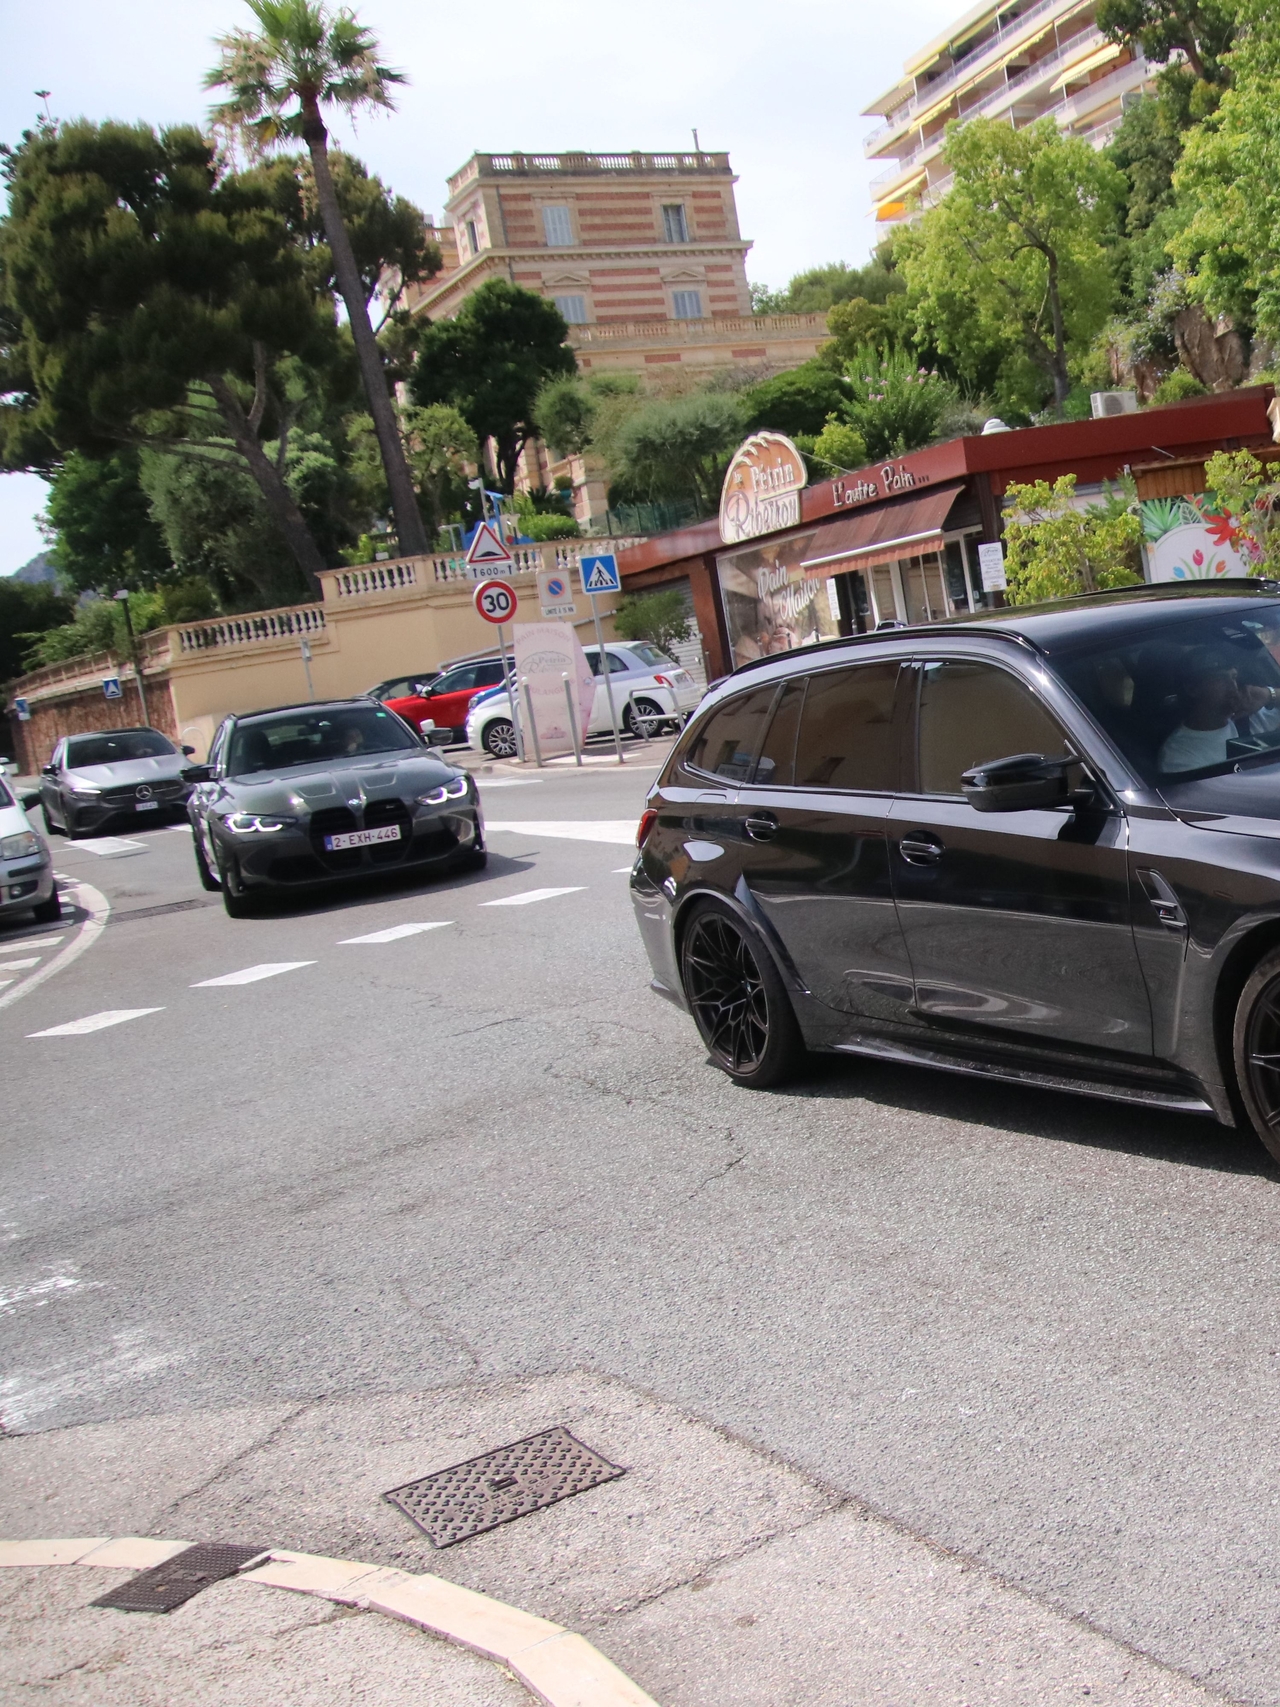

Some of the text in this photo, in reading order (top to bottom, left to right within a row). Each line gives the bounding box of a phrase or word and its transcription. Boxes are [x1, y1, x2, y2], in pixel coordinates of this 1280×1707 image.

[750, 457, 794, 493] Pétrin
[832, 480, 878, 506] L'autre
[758, 559, 788, 603] Pain
[483, 592, 510, 613] 30
[780, 578, 820, 620] Maison
[515, 627, 572, 645] PAIN MAISON
